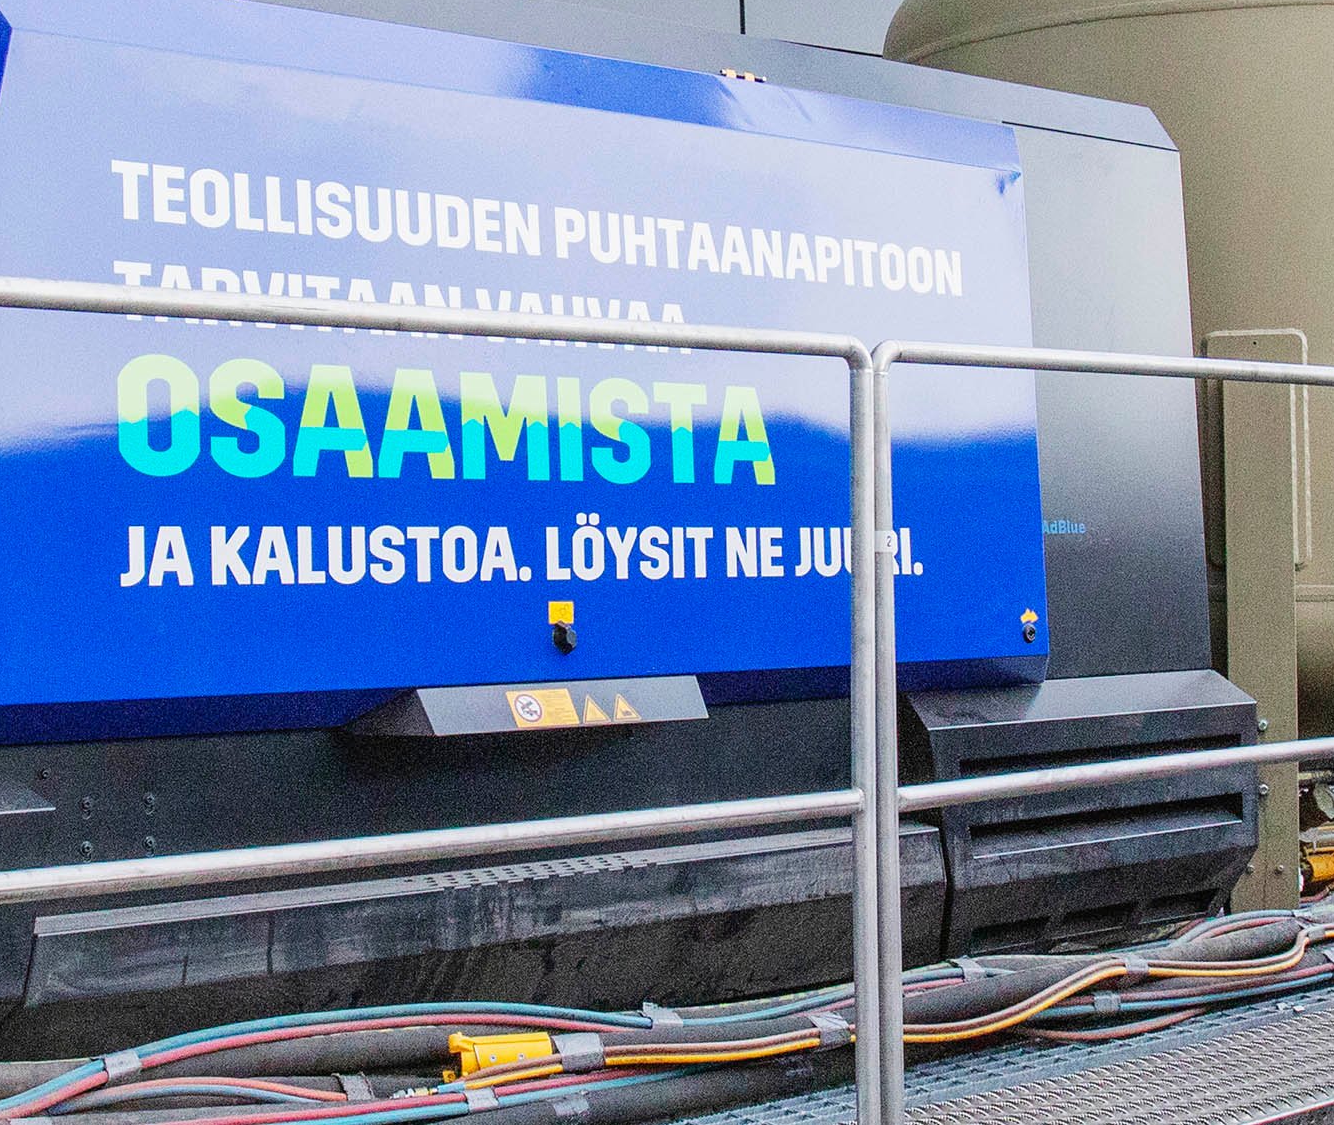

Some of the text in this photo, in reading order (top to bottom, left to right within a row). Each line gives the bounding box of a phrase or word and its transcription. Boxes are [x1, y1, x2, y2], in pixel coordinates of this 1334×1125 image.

[111, 160, 962, 296] TEOLLISUUDEN PUHTAANAPITOON
[117, 353, 776, 486] OSAAMISTA
[120, 512, 925, 587] JA KALUSTOA. LÖYSIT NE JUI.
[1042, 520, 1086, 534] AdBlue
